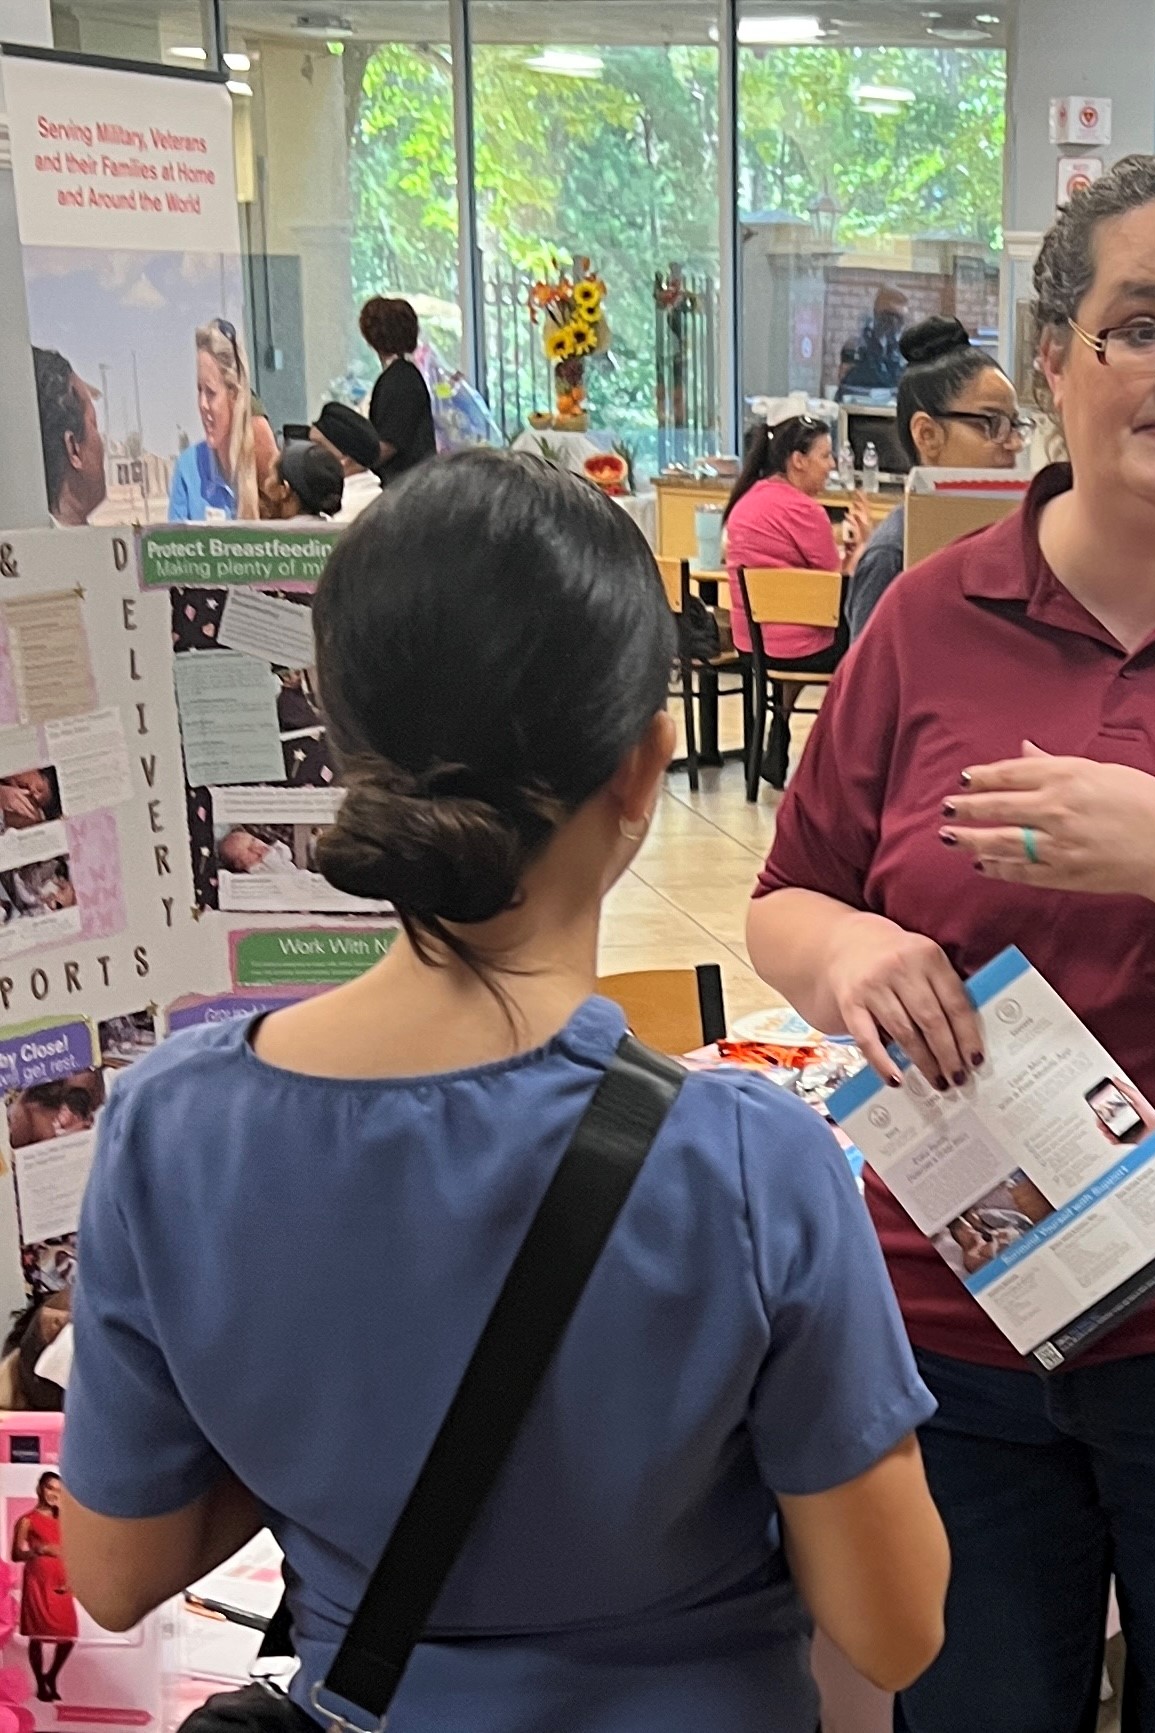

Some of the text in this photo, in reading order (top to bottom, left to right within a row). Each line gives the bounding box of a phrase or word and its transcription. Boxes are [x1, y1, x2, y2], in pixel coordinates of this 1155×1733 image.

[38, 115, 207, 153] Serving Military, Veterans
[35, 153, 216, 185] and their Families at Home
[58, 186, 202, 215] and Around the World
[0, 543, 20, 578] &
[147, 540, 205, 559] Protect
[156, 559, 211, 578] Making
[217, 558, 273, 579] plenty
[278, 559, 296, 576] of
[278, 937, 326, 955] Work
[328, 937, 370, 955] With
[20, 1033, 70, 1063] Close!
